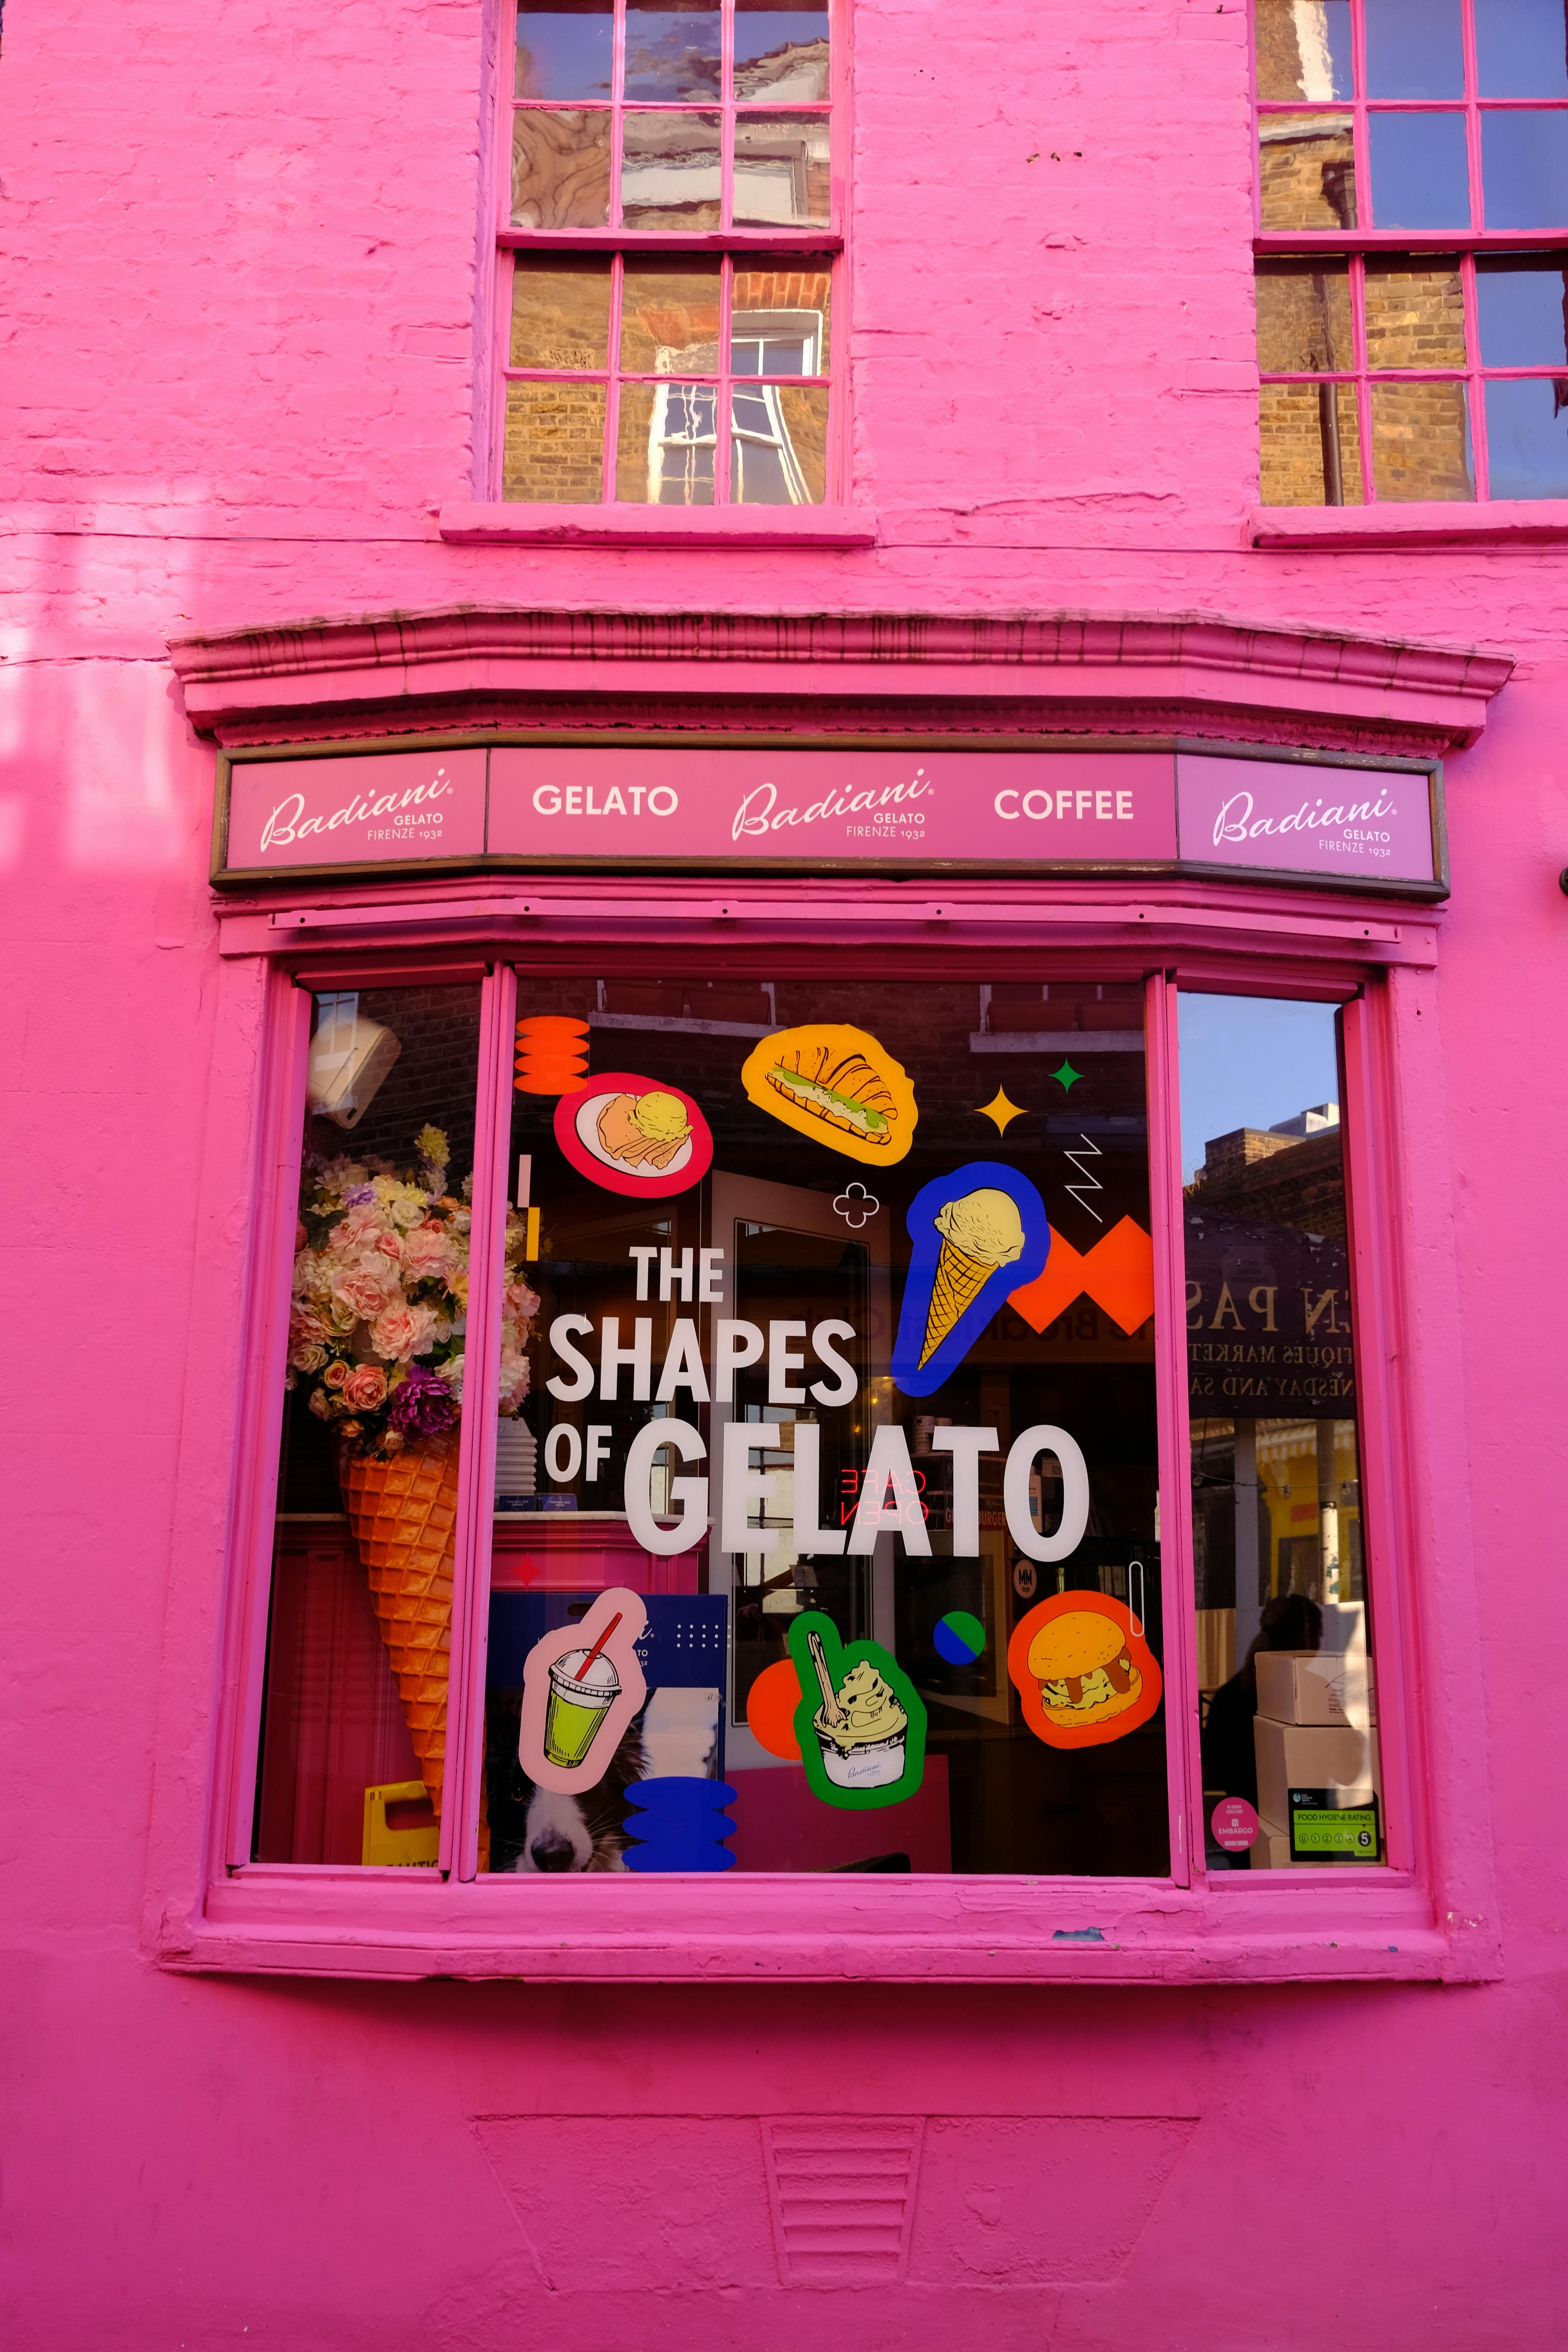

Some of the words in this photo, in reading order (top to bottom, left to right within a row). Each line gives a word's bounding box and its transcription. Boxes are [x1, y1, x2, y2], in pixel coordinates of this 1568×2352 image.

[260, 768, 450, 852] Badiani
[533, 785, 678, 816] GELATO
[732, 768, 930, 841] Badiani
[994, 789, 1134, 820] COFFEE
[394, 813, 443, 826] GELATO
[873, 812, 925, 824] GELATO
[1213, 788, 1393, 846] Badiani
[368, 828, 415, 841] FIRENZE
[419, 830, 443, 840] 1932
[847, 825, 896, 838] FIRENZE
[900, 830, 925, 840] 1932
[1343, 828, 1390, 843] GELATO
[1319, 839, 1364, 854] FIRENZE
[1368, 848, 1391, 858] 1932
[628, 1246, 724, 1303] THE
[545, 1313, 859, 1407] SHAPES
[544, 1423, 612, 1483] OF
[624, 1418, 1089, 1562] GELATO
[1018, 1568, 1032, 1586] MM
[1319, 1813, 1347, 1822] HYGIENE
[1361, 1832, 1369, 1846] 5
